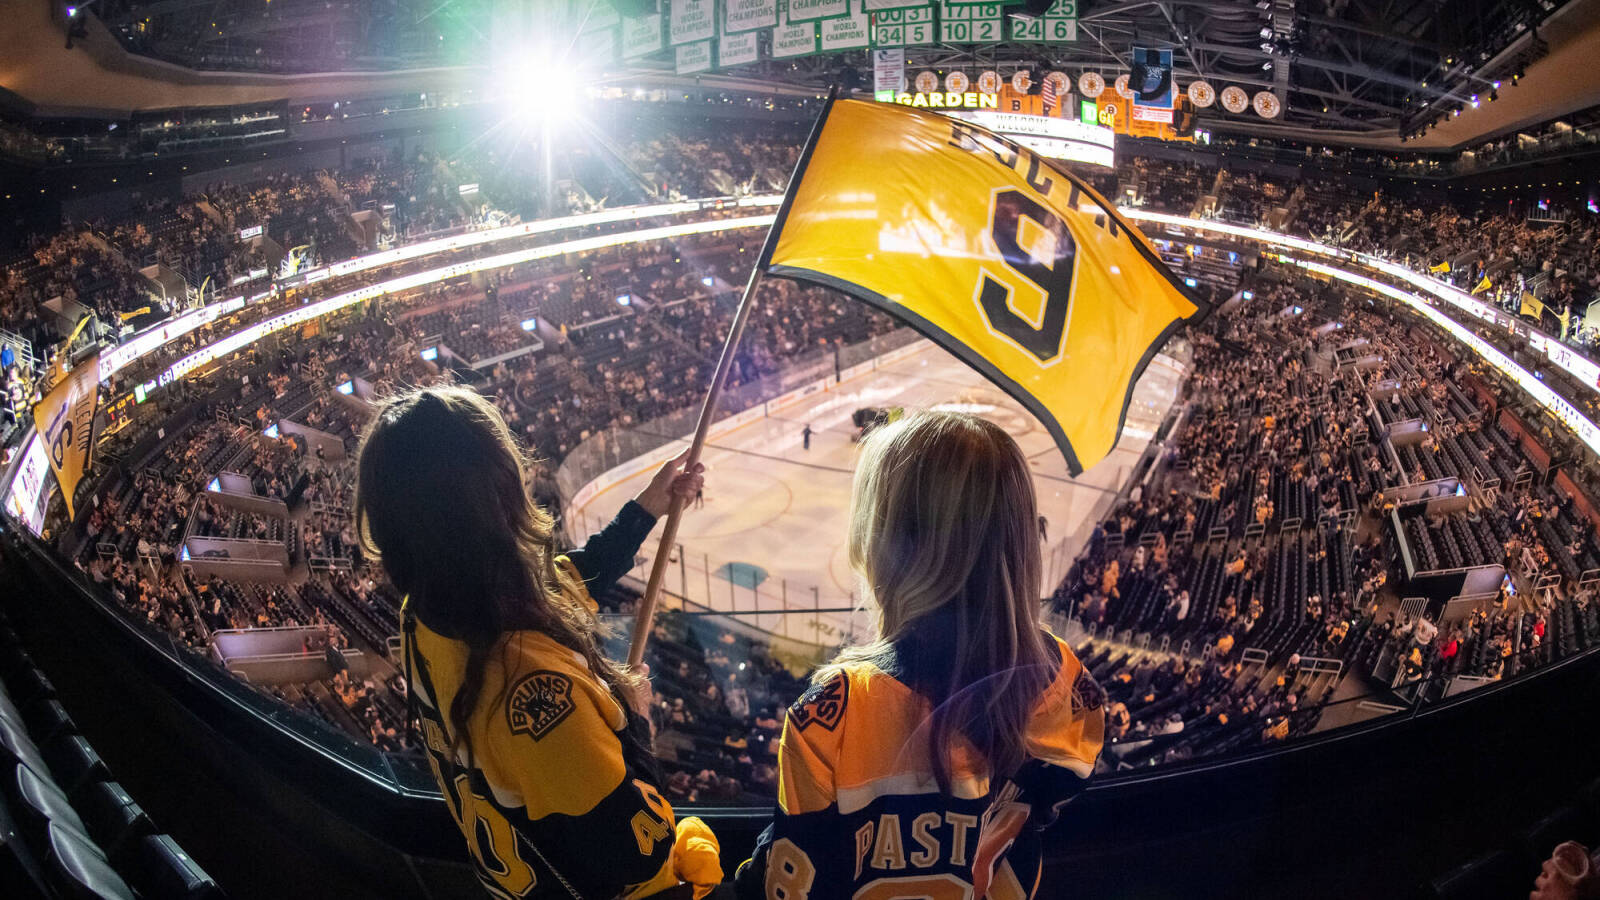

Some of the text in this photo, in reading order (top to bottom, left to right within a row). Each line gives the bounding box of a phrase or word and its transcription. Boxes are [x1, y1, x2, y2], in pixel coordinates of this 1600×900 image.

[792, 0, 842, 9] CHAMPION
[948, 6, 964, 17] 17
[979, 5, 997, 17] 18
[1048, 0, 1074, 15] 25
[729, 6, 773, 21] CHAMPIONS
[908, 9, 929, 20] 31
[833, 22, 857, 31] WORLD
[913, 27, 924, 41] 5
[944, 23, 967, 40] 10
[980, 23, 993, 39] 2
[1014, 21, 1041, 38] 24
[1054, 21, 1067, 39] 6
[826, 31, 864, 42] CHAMPIONS
[880, 28, 901, 44] 34
[896, 92, 998, 108] GARDEN
[1012, 100, 1021, 111] B
[973, 186, 1081, 369] 9
[46, 401, 73, 471] 16
[512, 676, 566, 727] BRUINS
[854, 810, 992, 881] PAST
